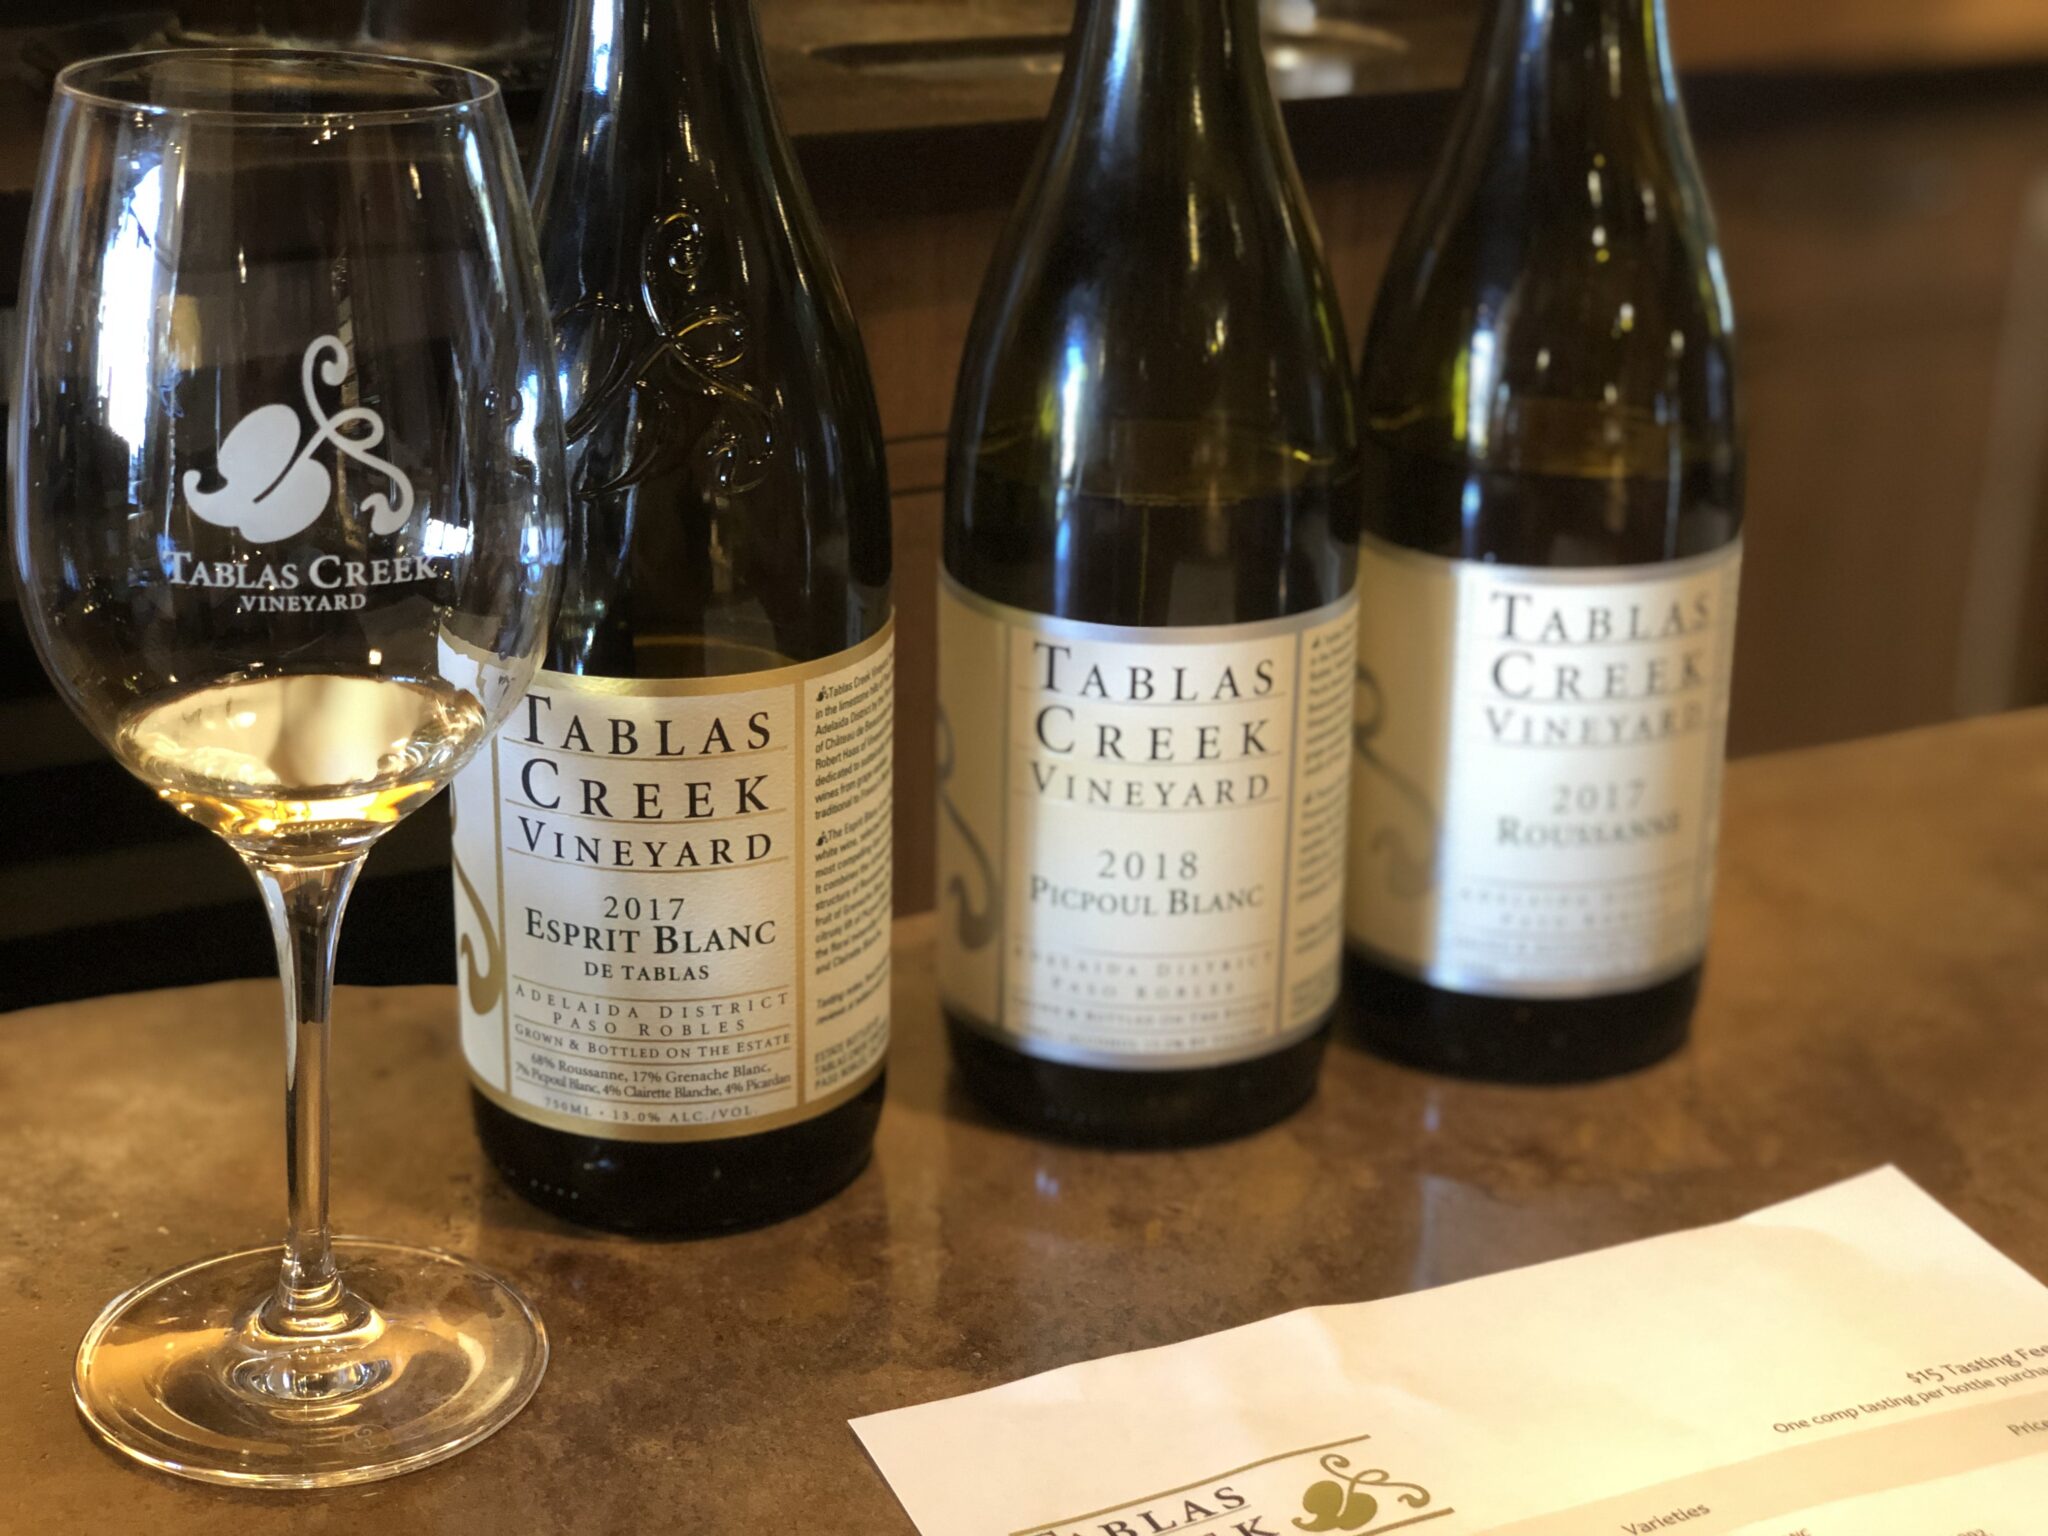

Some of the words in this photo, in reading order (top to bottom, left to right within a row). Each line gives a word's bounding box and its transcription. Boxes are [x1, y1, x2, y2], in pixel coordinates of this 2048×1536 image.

[164, 551, 299, 589] TABLAS
[309, 554, 438, 589] CREEK
[241, 592, 367, 612] VINEYARD
[1033, 641, 1275, 701] TABLAS
[524, 693, 771, 756] TABLAS
[1035, 704, 1271, 761] CREEK
[521, 758, 769, 819] CREEK
[1030, 760, 1271, 807] VINEYARD
[518, 816, 772, 867] VINEYARD
[1097, 850, 1199, 881] 2018
[604, 896, 685, 921] 2017
[1030, 874, 1158, 917] PICPOUL
[1168, 886, 1264, 916] BLANC
[524, 906, 641, 953] ESPRIT
[653, 920, 776, 954] BLANC
[584, 961, 614, 978] DE
[621, 964, 709, 981] TABLAS
[515, 983, 638, 1018] ADELAIDA
[659, 992, 788, 1019] DISTRICT
[514, 1023, 563, 1047] GROWN
[569, 1039, 579, 1050] &
[588, 1042, 659, 1058] BOTTLED
[666, 1047, 691, 1059] ON
[697, 1045, 730, 1057] THE
[737, 1033, 790, 1053] ESTATE
[553, 1011, 617, 1034] PASO
[639, 1019, 744, 1037] ROBLES
[531, 1053, 555, 1070] 68%
[558, 1059, 628, 1082] Roussanne,
[633, 1071, 661, 1084] 17%
[666, 1068, 729, 1083] Grenache
[531, 1067, 567, 1088] Picpoul
[602, 1084, 622, 1096] 4%
[624, 1085, 671, 1099] Clairette
[725, 1084, 743, 1095] 4%
[746, 1074, 791, 1091] Picardan
[545, 1097, 592, 1116] 750ML
[1905, 1368, 1945, 1385] $15
[1938, 1353, 2023, 1376] Tasting
[1771, 1416, 1811, 1436] One
[1811, 1404, 1860, 1428] comp
[1857, 1393, 1921, 1419] tasting
[1917, 1386, 1945, 1404] per
[1942, 1378, 1996, 1395] bottle
[1621, 1501, 1712, 1536] Varieties
